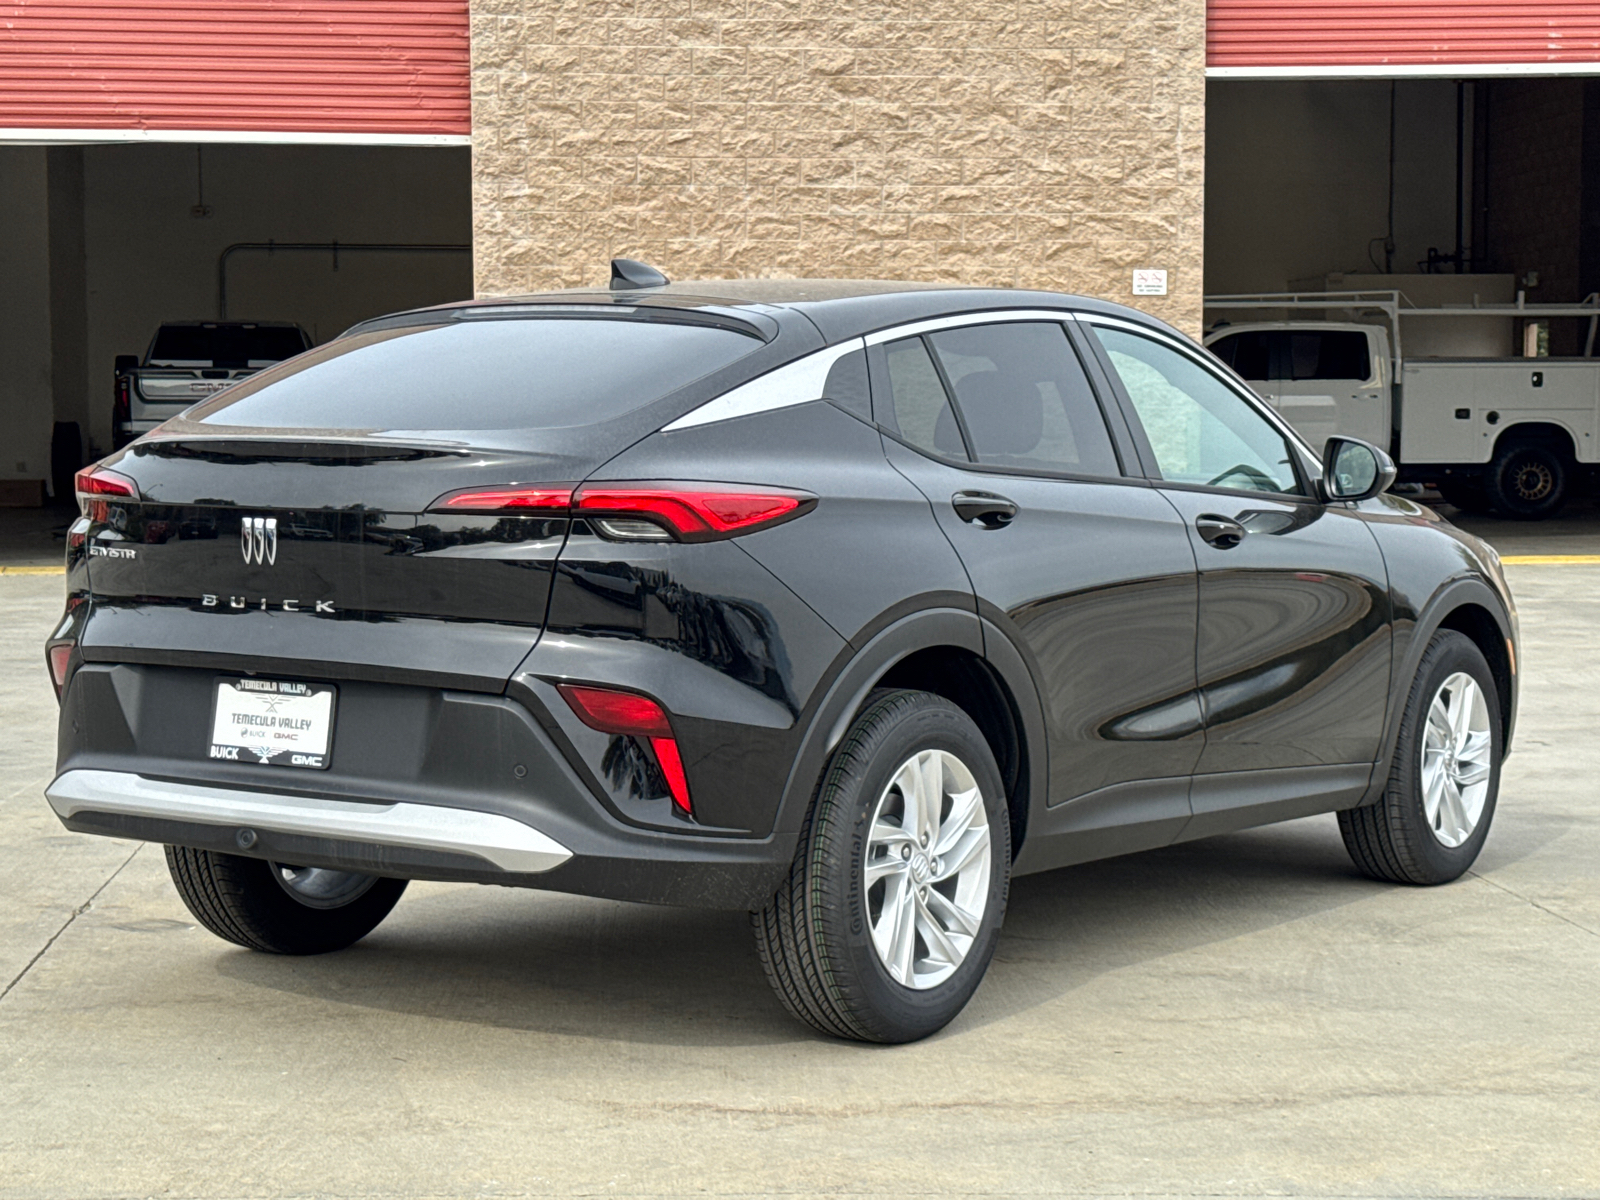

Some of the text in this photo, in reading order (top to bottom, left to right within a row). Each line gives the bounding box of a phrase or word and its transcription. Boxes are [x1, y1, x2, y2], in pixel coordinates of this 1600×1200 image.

[190, 383, 233, 393] GM
[202, 594, 335, 613] BUICK
[240, 679, 307, 694] TEMECULA VALLEY
[232, 713, 312, 731] TEMECULA VALLEY
[249, 730, 266, 738] BUICK
[273, 732, 299, 741] GMC
[210, 745, 239, 760] BUICK
[291, 755, 323, 767] GMC
[847, 833, 862, 935] Continental
